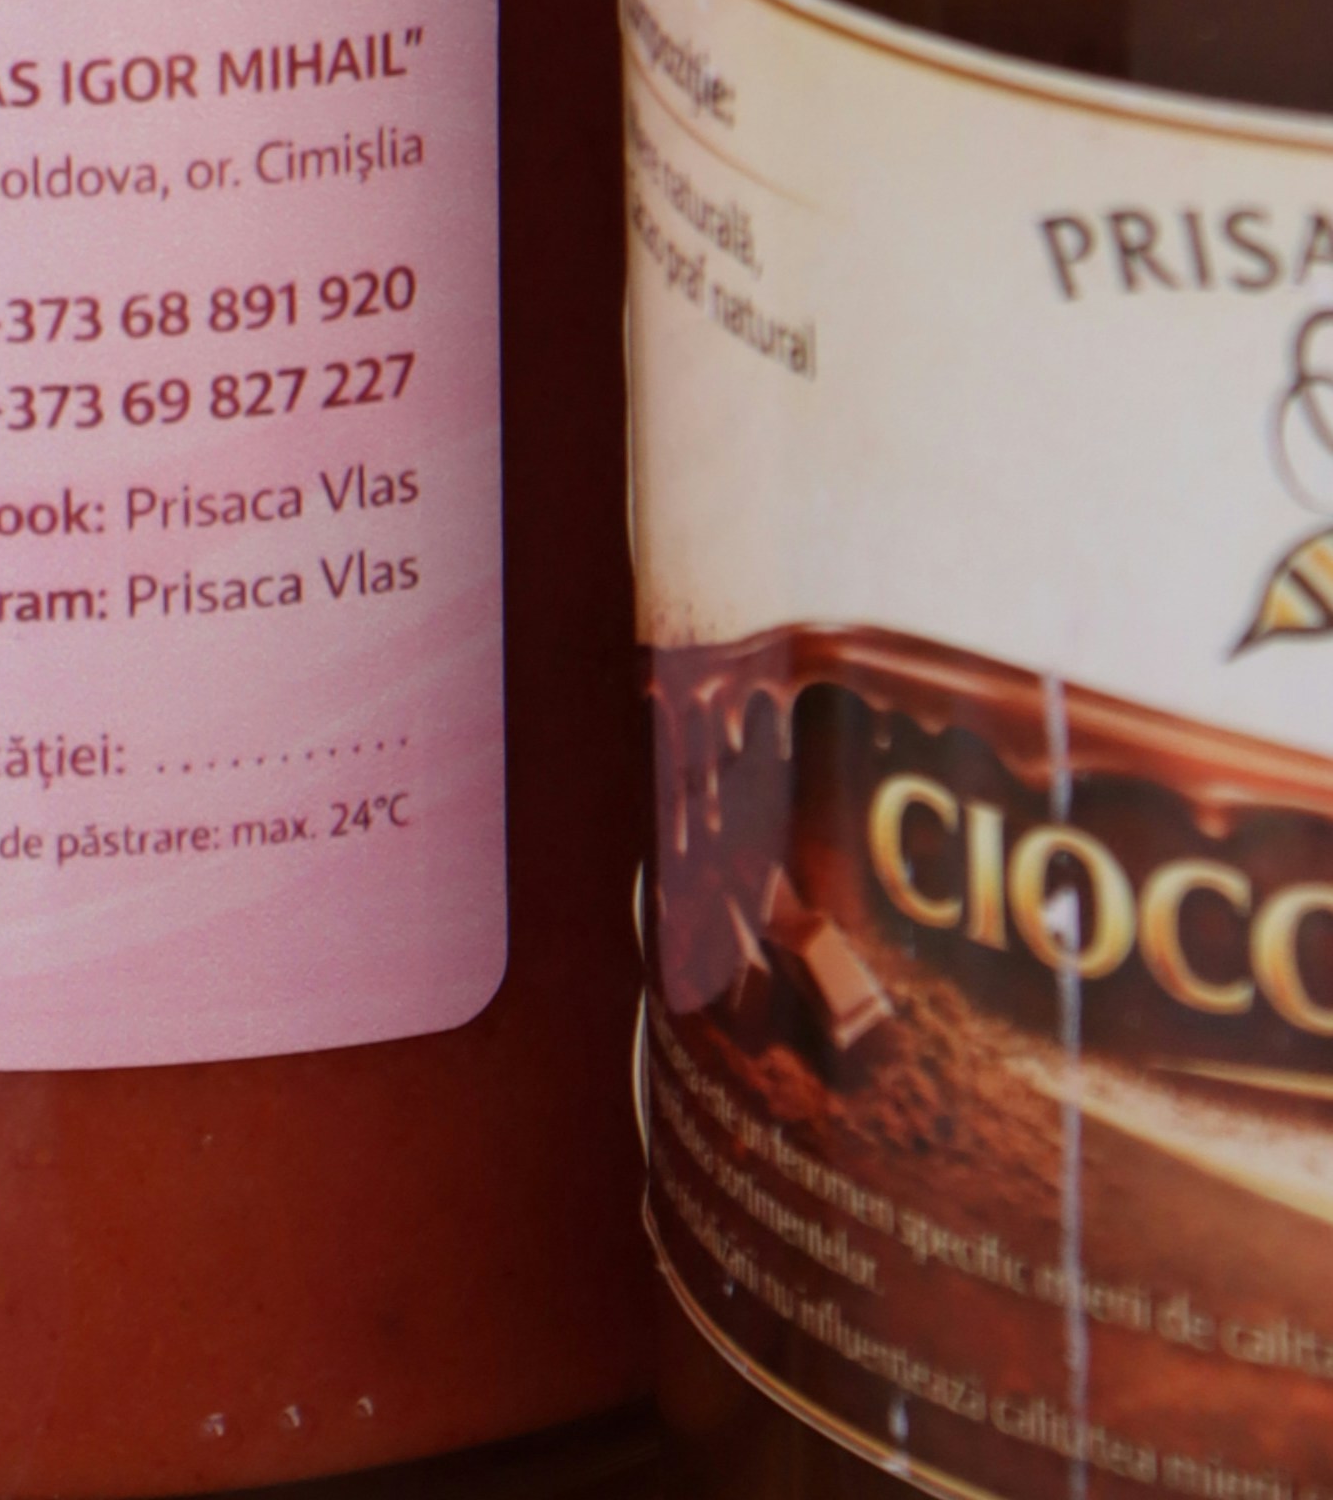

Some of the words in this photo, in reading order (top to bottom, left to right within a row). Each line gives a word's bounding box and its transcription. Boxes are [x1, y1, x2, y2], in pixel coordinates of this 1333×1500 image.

[61, 54, 199, 106] IGOR
[185, 155, 241, 192] or.
[1039, 204, 1333, 301] PRISA
[119, 290, 191, 340] 68
[208, 281, 299, 334] 891
[318, 264, 418, 323] 920
[711, 278, 818, 384] natural
[120, 377, 192, 427] 69
[209, 365, 308, 421] 827
[320, 351, 417, 410] 227
[127, 484, 304, 531] Prisaca
[319, 463, 420, 513] Vlas
[127, 571, 304, 618] Prisaca
[320, 549, 421, 601] Vlas
[56, 821, 221, 866] păstrare:
[233, 816, 317, 848] max.
